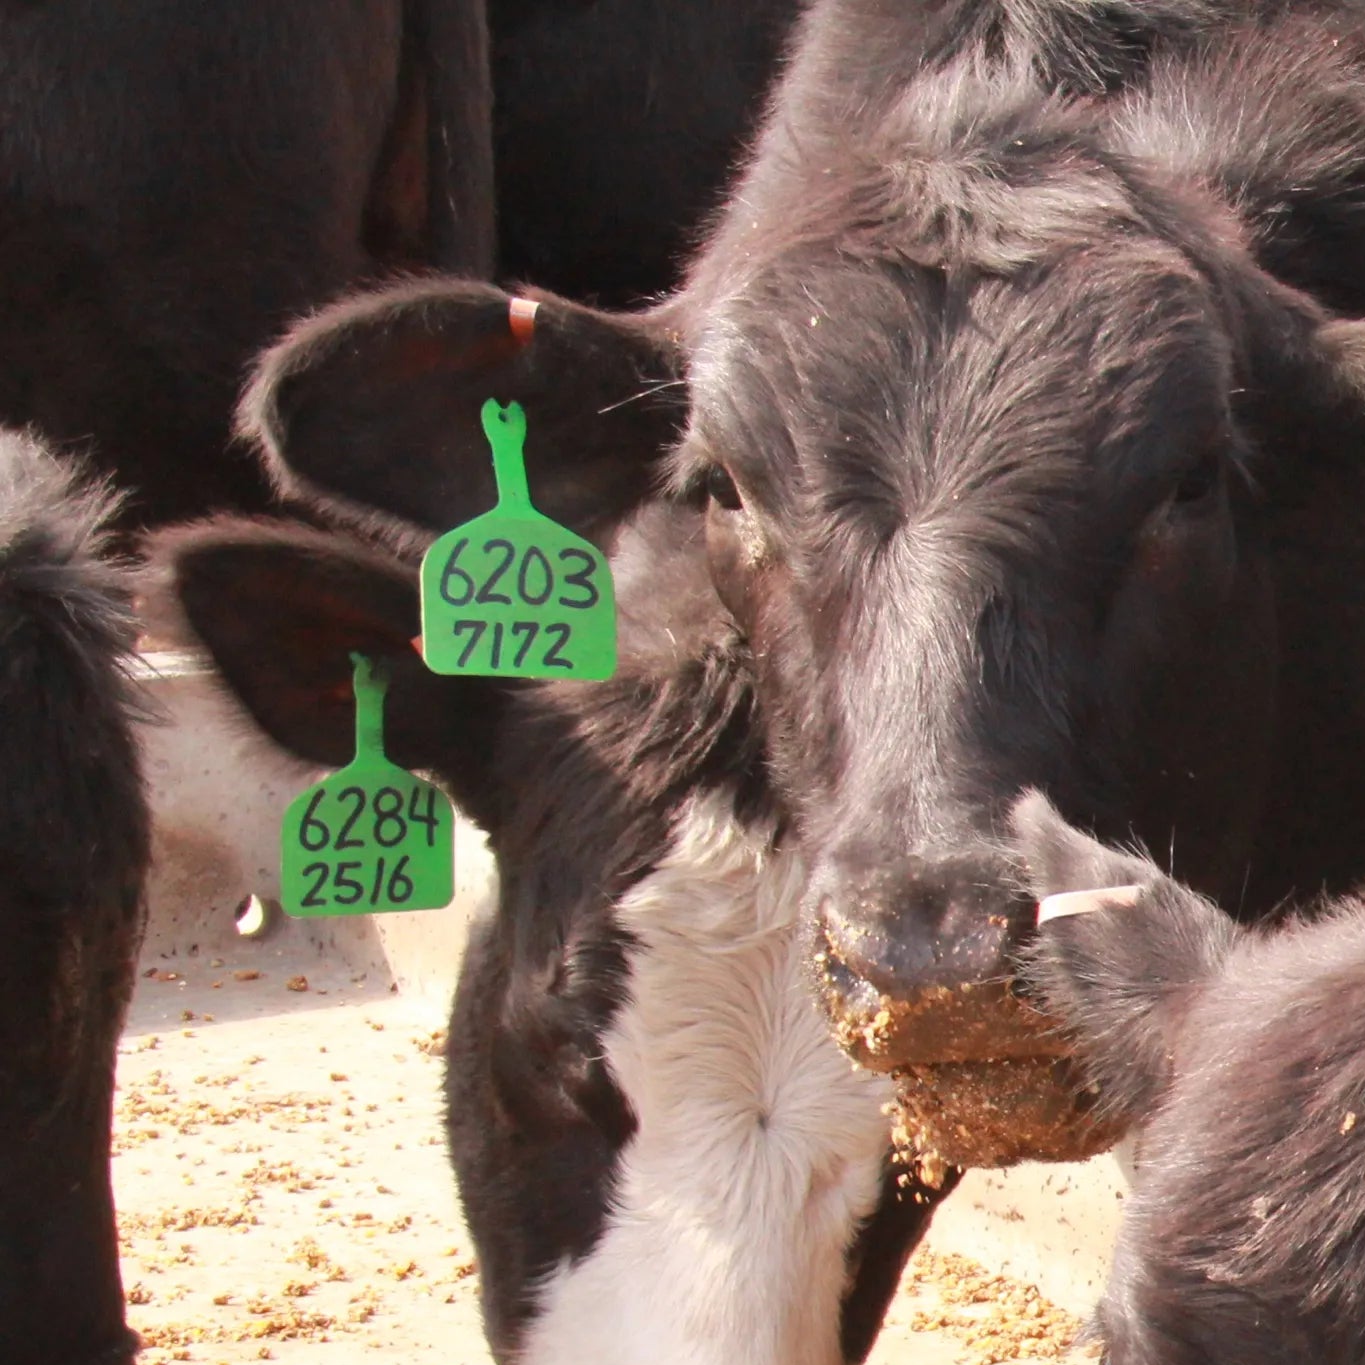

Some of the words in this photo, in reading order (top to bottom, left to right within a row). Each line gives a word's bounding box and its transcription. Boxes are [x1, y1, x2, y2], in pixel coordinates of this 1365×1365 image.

[436, 538, 599, 609] 6203
[452, 619, 574, 669] 7172
[299, 787, 438, 847] 6284
[300, 859, 412, 906] 2516
